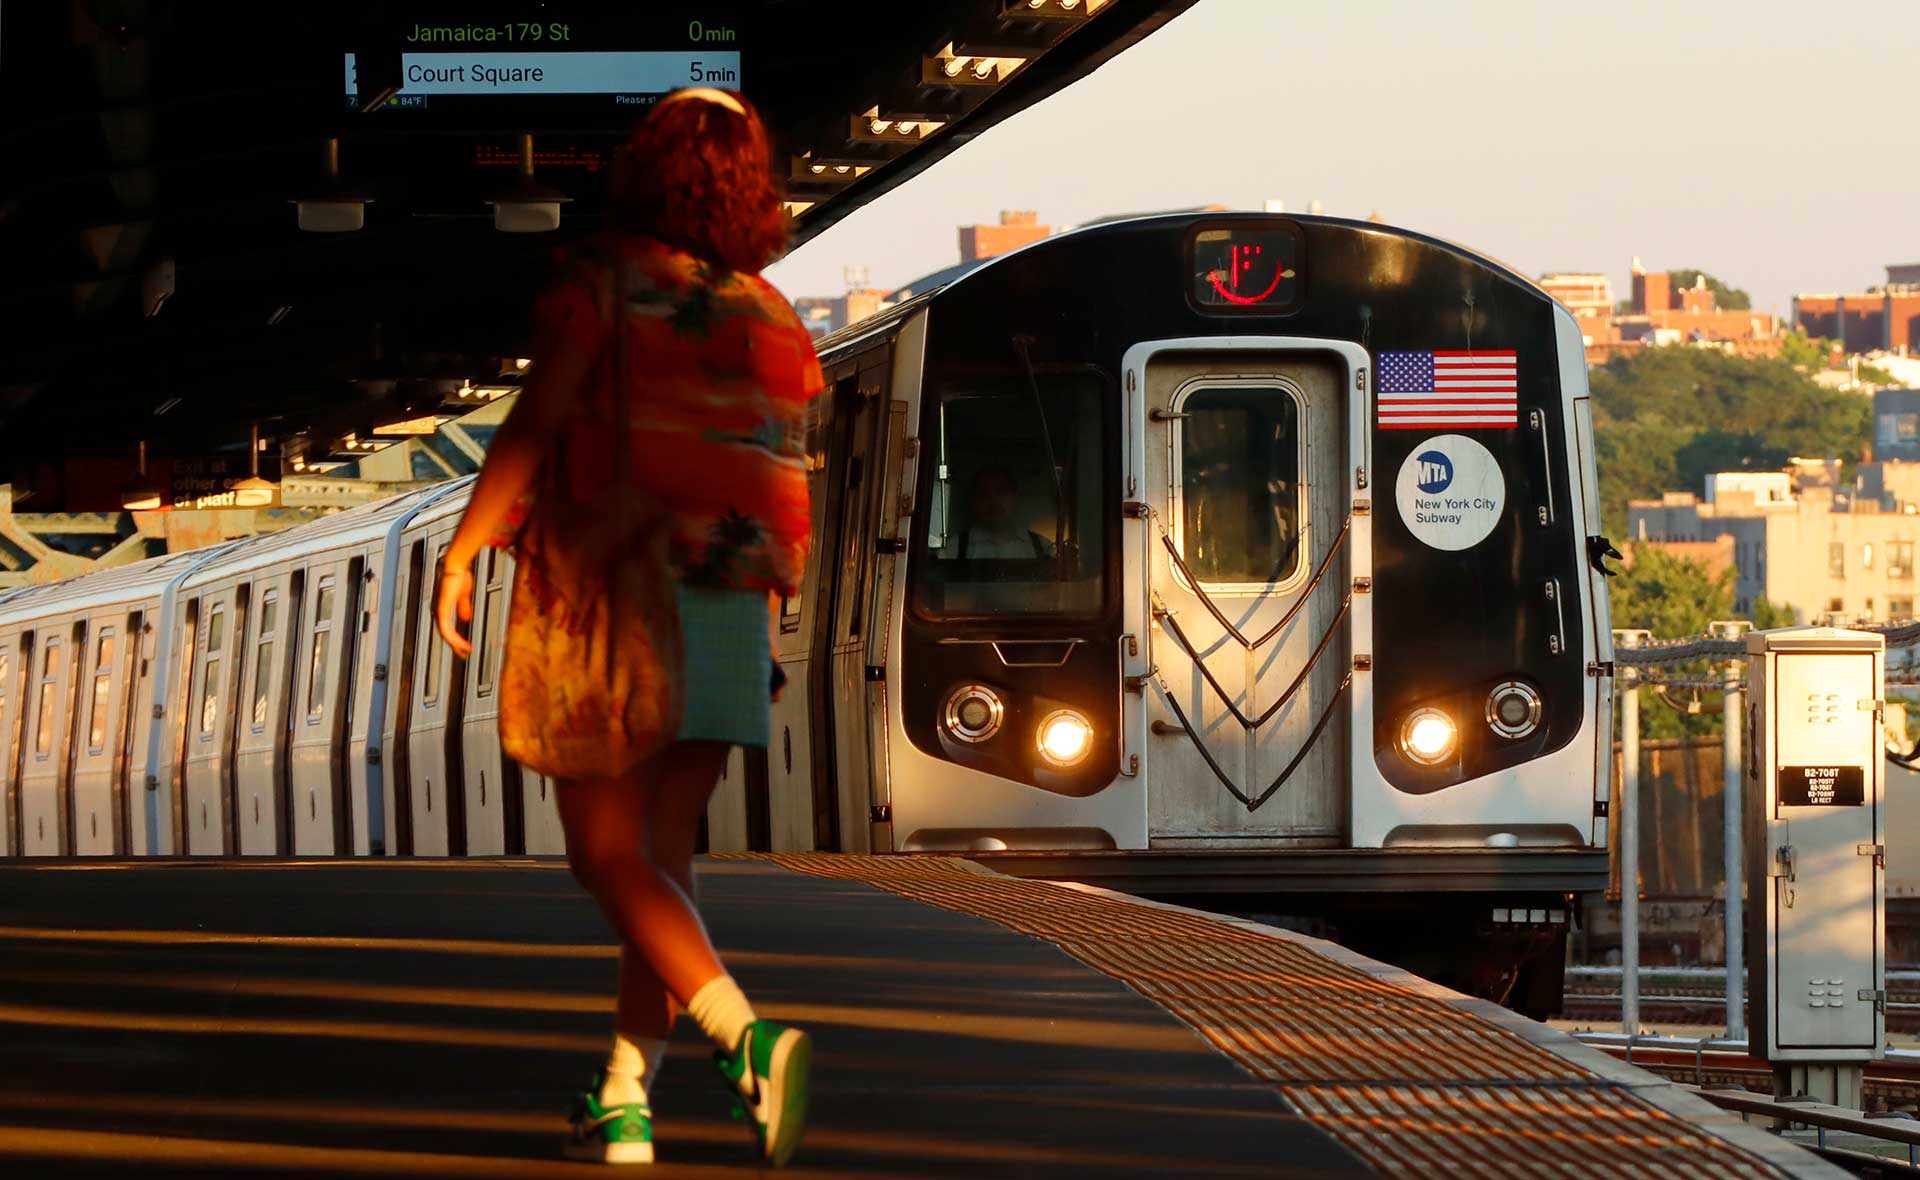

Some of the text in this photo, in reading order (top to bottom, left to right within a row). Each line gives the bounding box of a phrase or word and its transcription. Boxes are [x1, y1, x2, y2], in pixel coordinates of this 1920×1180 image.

[407, 23, 570, 42] Jamaica-179 St
[689, 20, 736, 41] 0 min
[408, 64, 544, 86] Court Square
[690, 61, 736, 82] 5 min
[616, 95, 646, 104] Please
[1416, 460, 1447, 485] MTA
[174, 477, 216, 490] other
[174, 493, 191, 508] of
[1415, 499, 1496, 511] New York City
[1416, 513, 1461, 524] Subway
[1804, 768, 1839, 777] B2-708T
